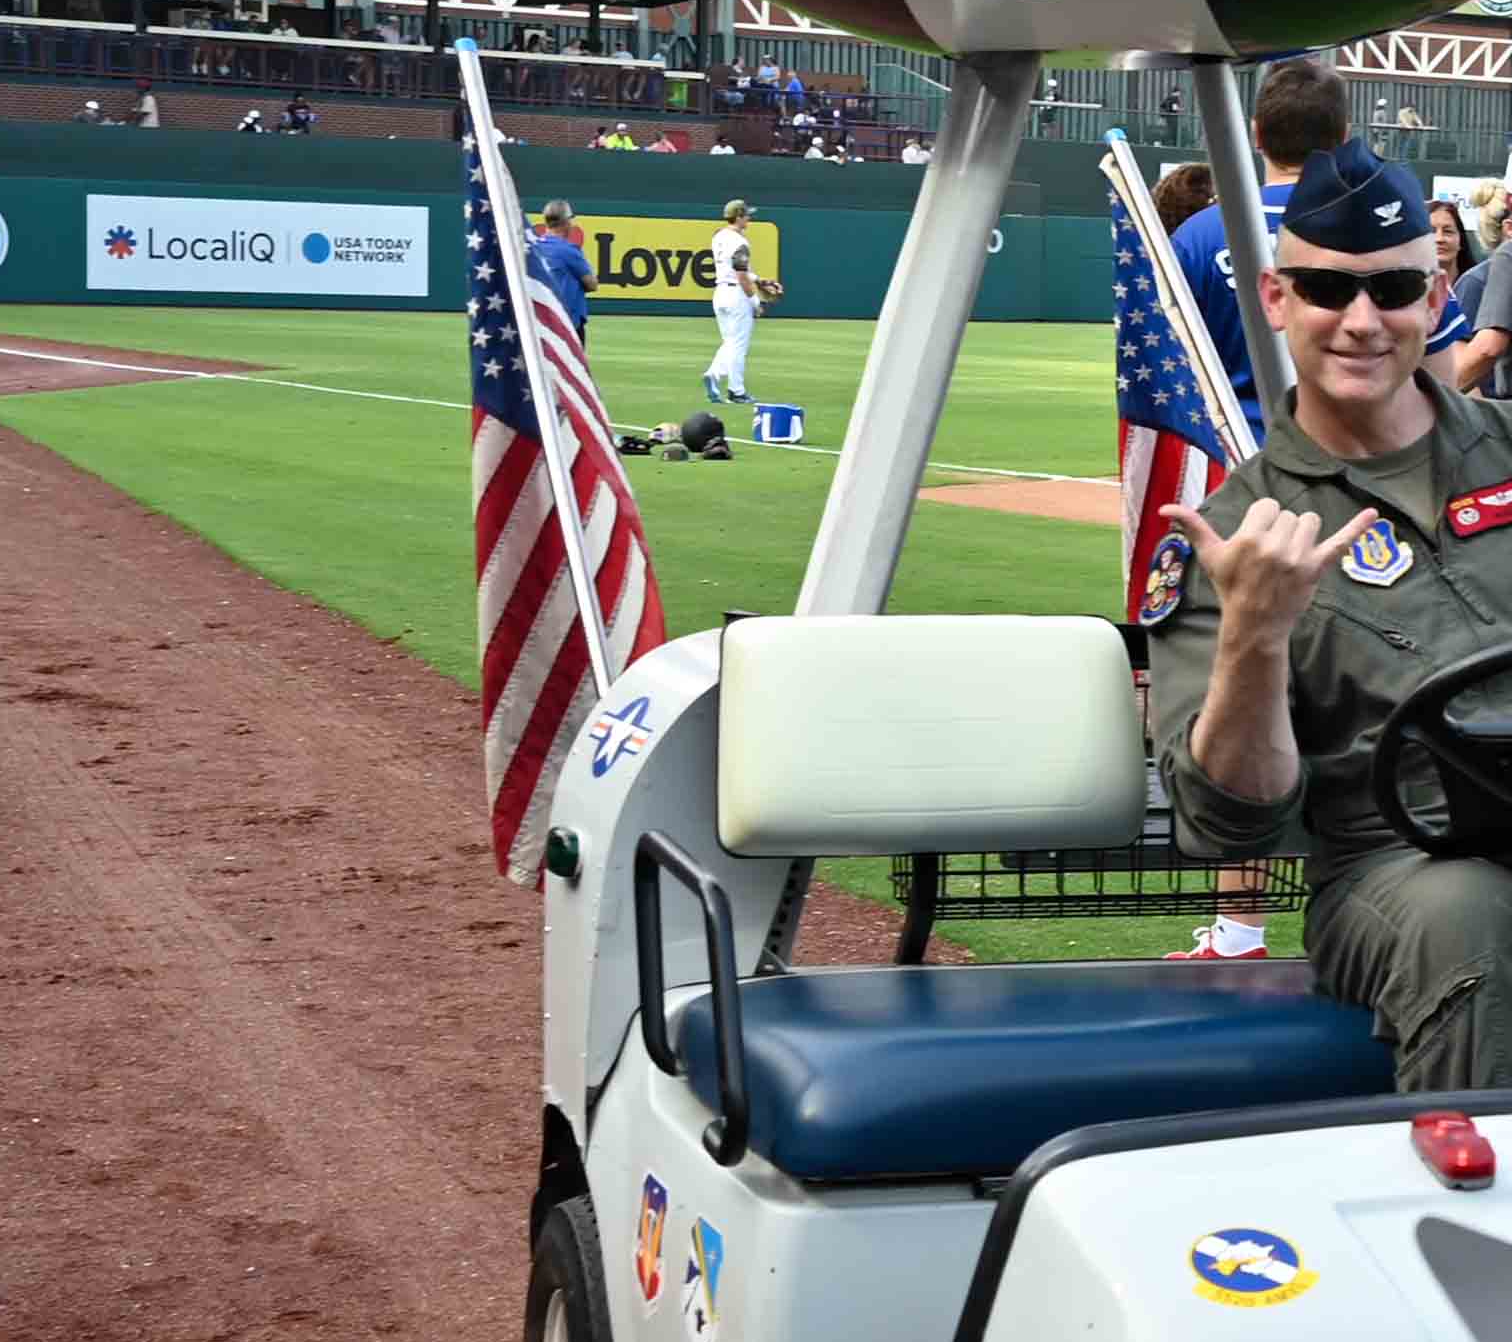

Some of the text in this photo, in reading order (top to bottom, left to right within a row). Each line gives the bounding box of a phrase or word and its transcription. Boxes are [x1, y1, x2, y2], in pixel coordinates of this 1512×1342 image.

[147, 227, 276, 263] LocaliQ
[334, 237, 413, 252] USA TODAY
[333, 249, 405, 263] NETWORK
